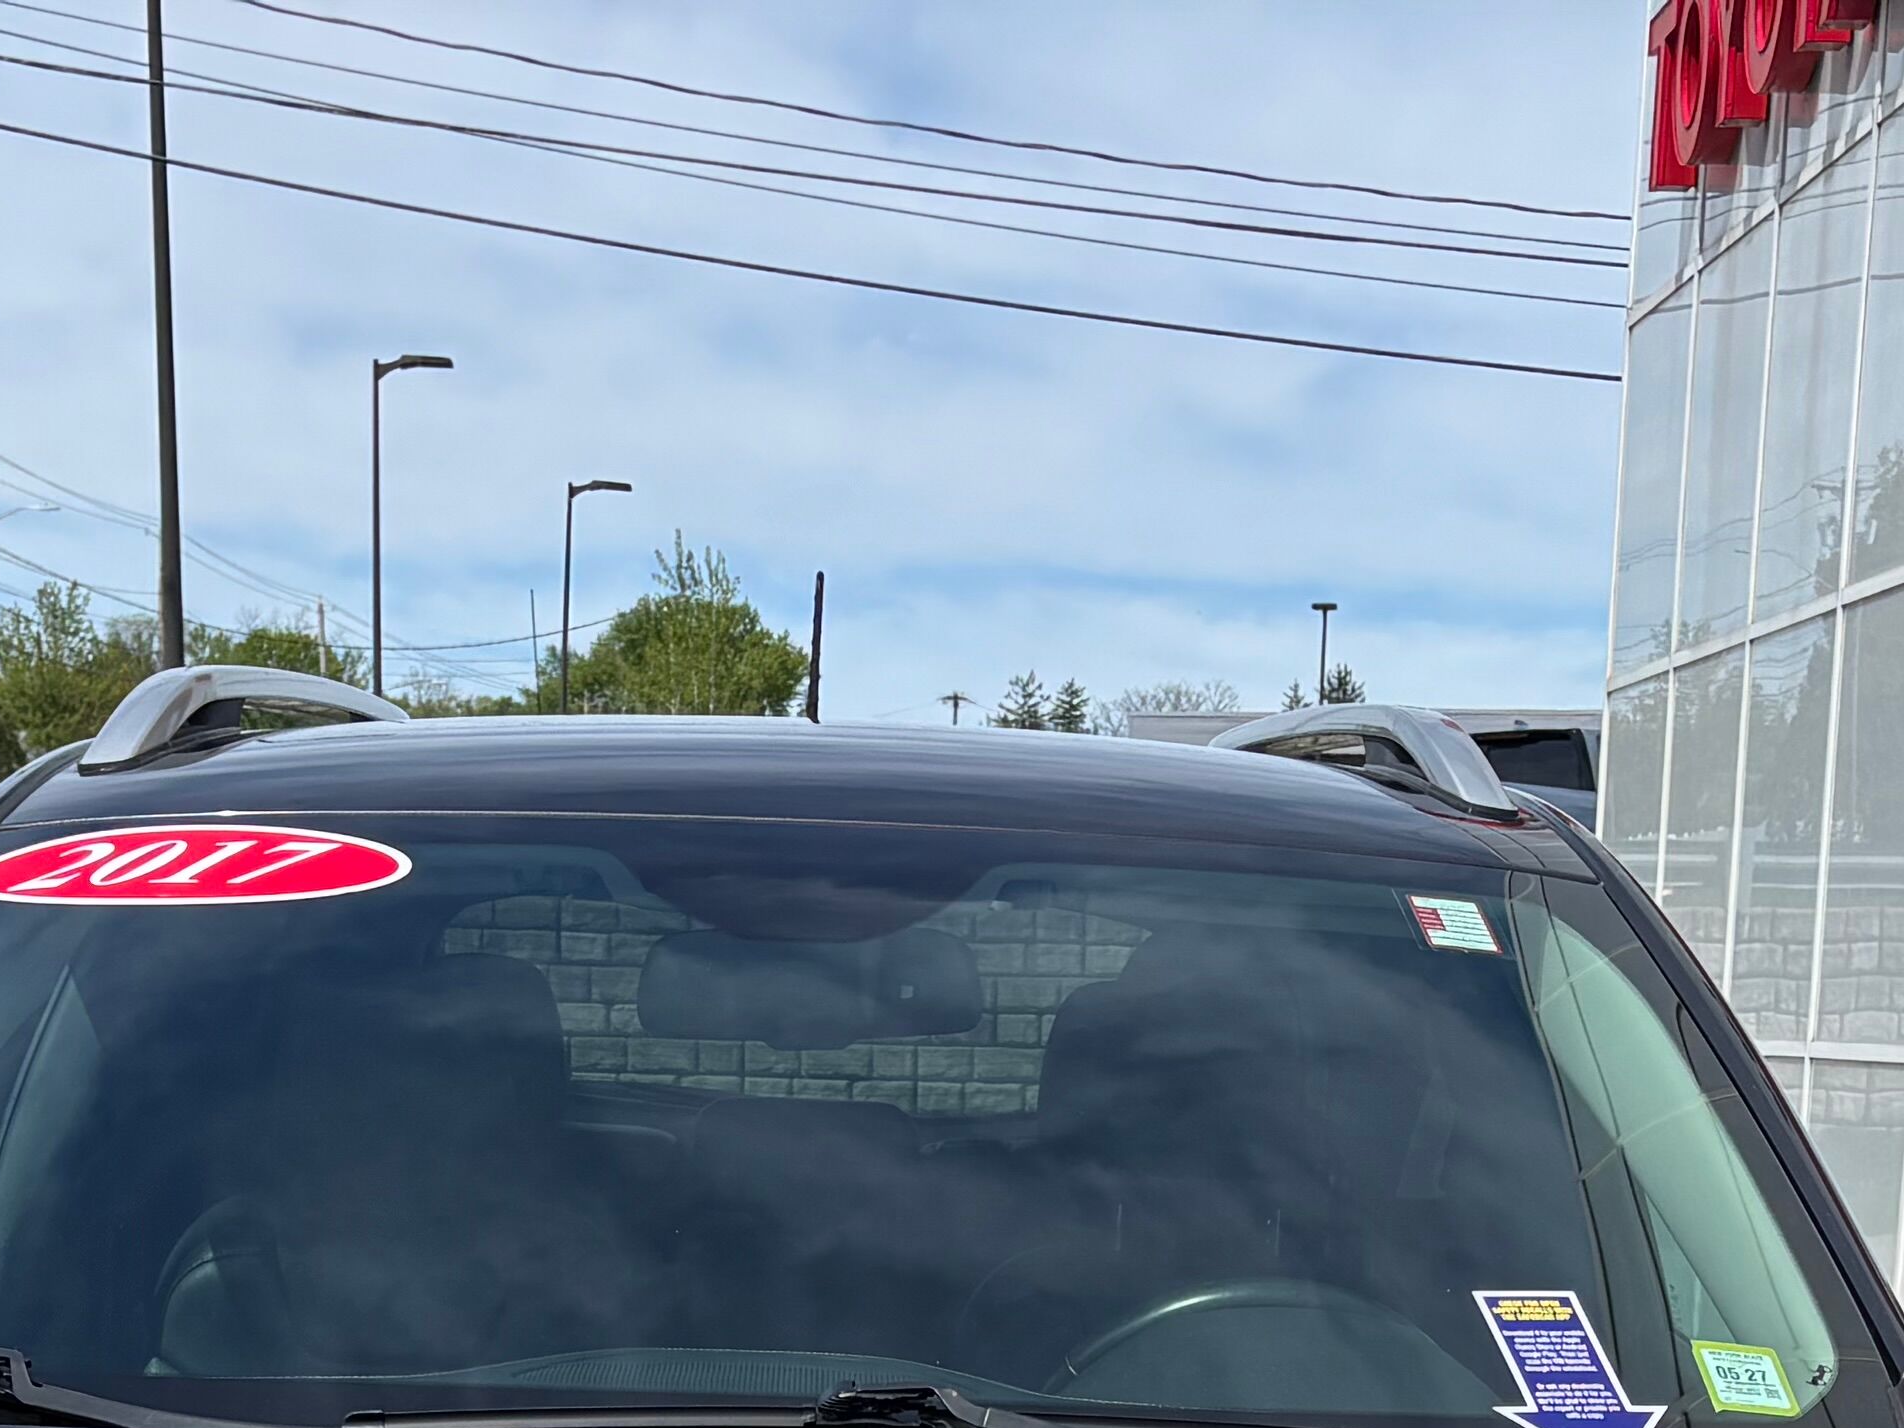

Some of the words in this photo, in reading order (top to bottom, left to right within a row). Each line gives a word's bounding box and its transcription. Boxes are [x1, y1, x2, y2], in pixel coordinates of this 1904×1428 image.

[7, 839, 341, 892] 2017
[1716, 1365, 1741, 1380] 05
[1746, 1368, 1767, 1384] 27
